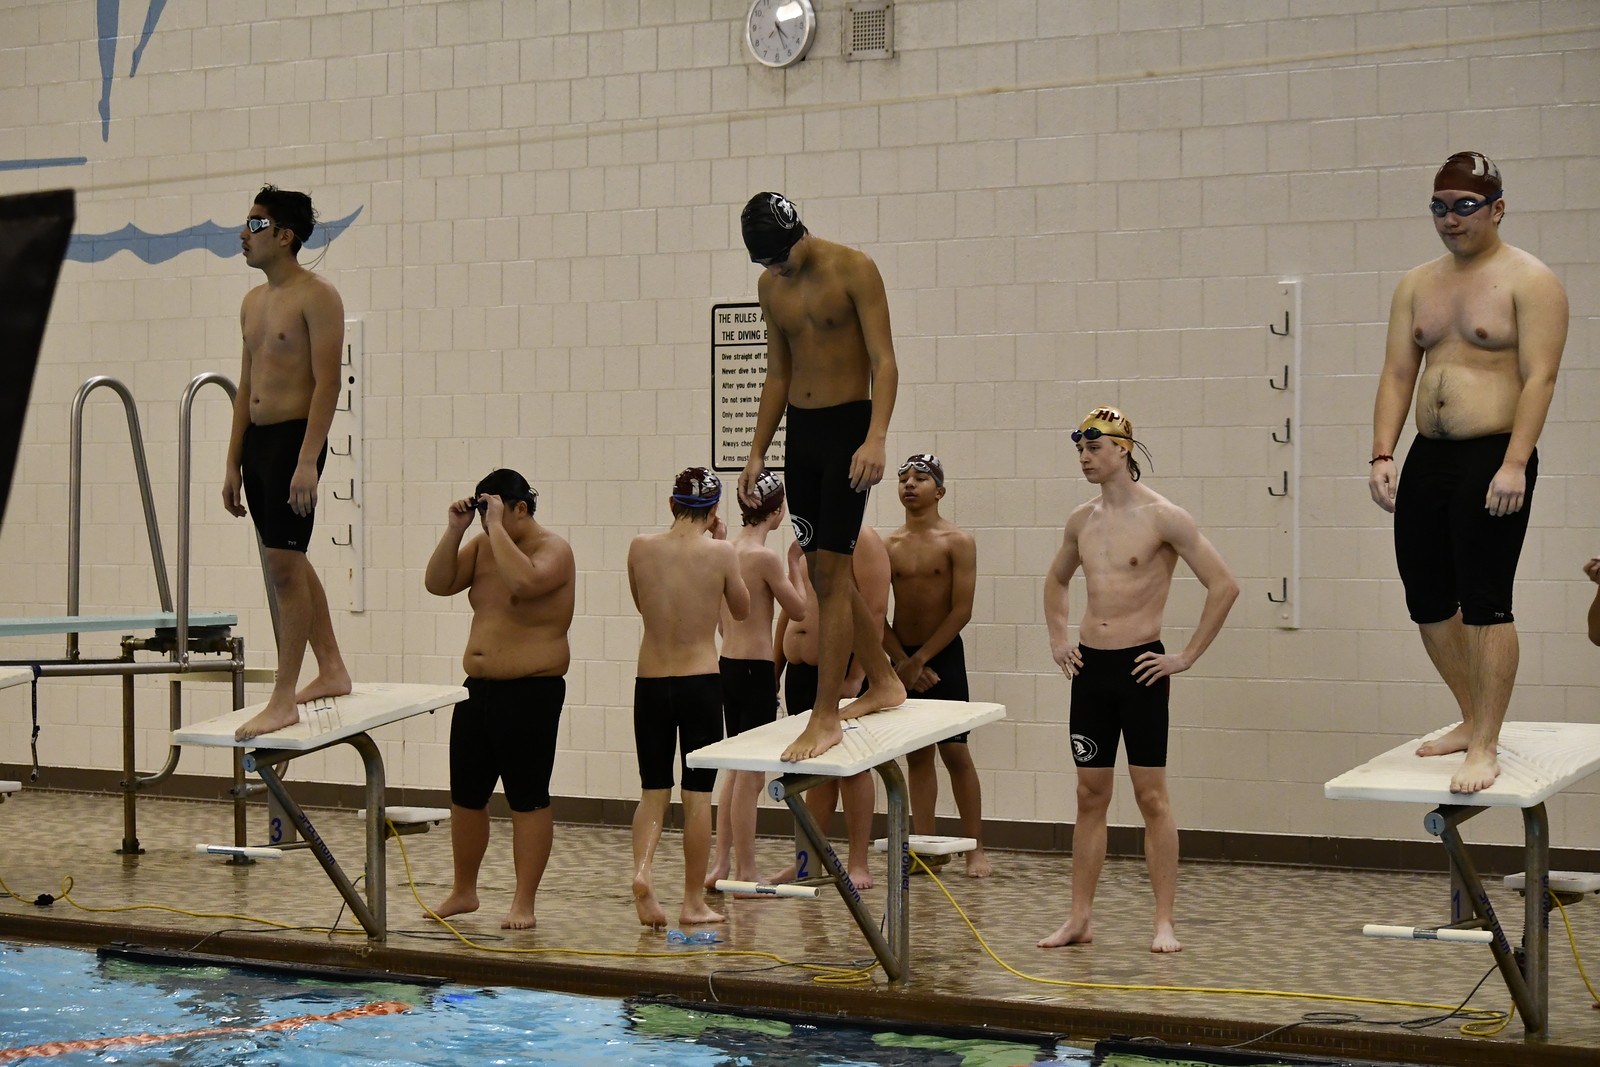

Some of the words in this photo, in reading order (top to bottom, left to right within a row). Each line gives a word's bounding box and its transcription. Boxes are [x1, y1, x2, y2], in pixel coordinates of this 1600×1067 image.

[755, 39, 760, 47] 8
[719, 313, 731, 323] THE
[735, 313, 757, 323] RULES
[722, 331, 735, 341] THE
[738, 330, 761, 340] DIVING
[734, 353, 753, 362] straight
[722, 411, 733, 419] Only
[722, 426, 733, 434] Only
[722, 440, 739, 448] Always
[774, 786, 779, 797] 2
[1432, 819, 1437, 829] 1
[271, 817, 282, 842] 3
[797, 850, 808, 879] 2
[1453, 889, 1460, 919] 1
